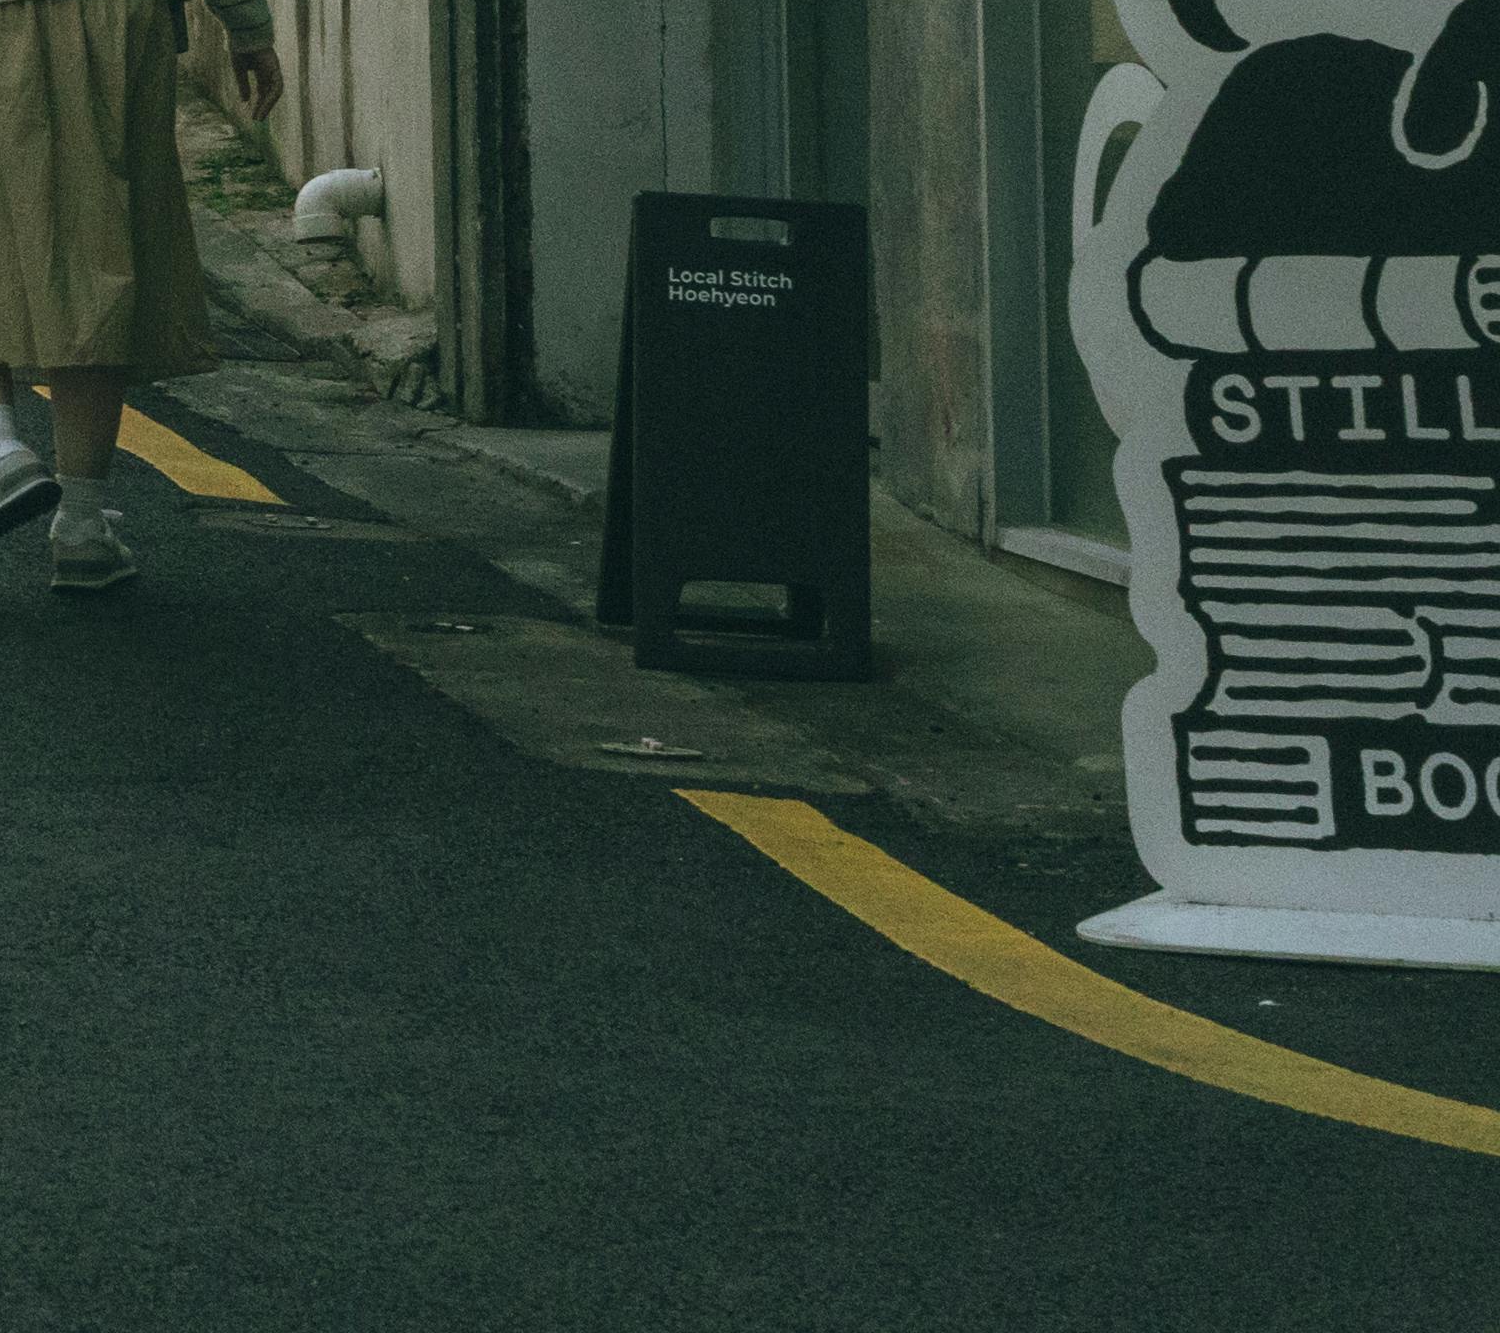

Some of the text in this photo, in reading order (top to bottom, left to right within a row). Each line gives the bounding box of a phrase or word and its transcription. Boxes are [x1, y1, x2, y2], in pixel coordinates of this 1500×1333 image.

[668, 267, 793, 290] Local Stitch
[668, 286, 777, 309] Hoehyeon
[1210, 373, 1500, 445] STILL
